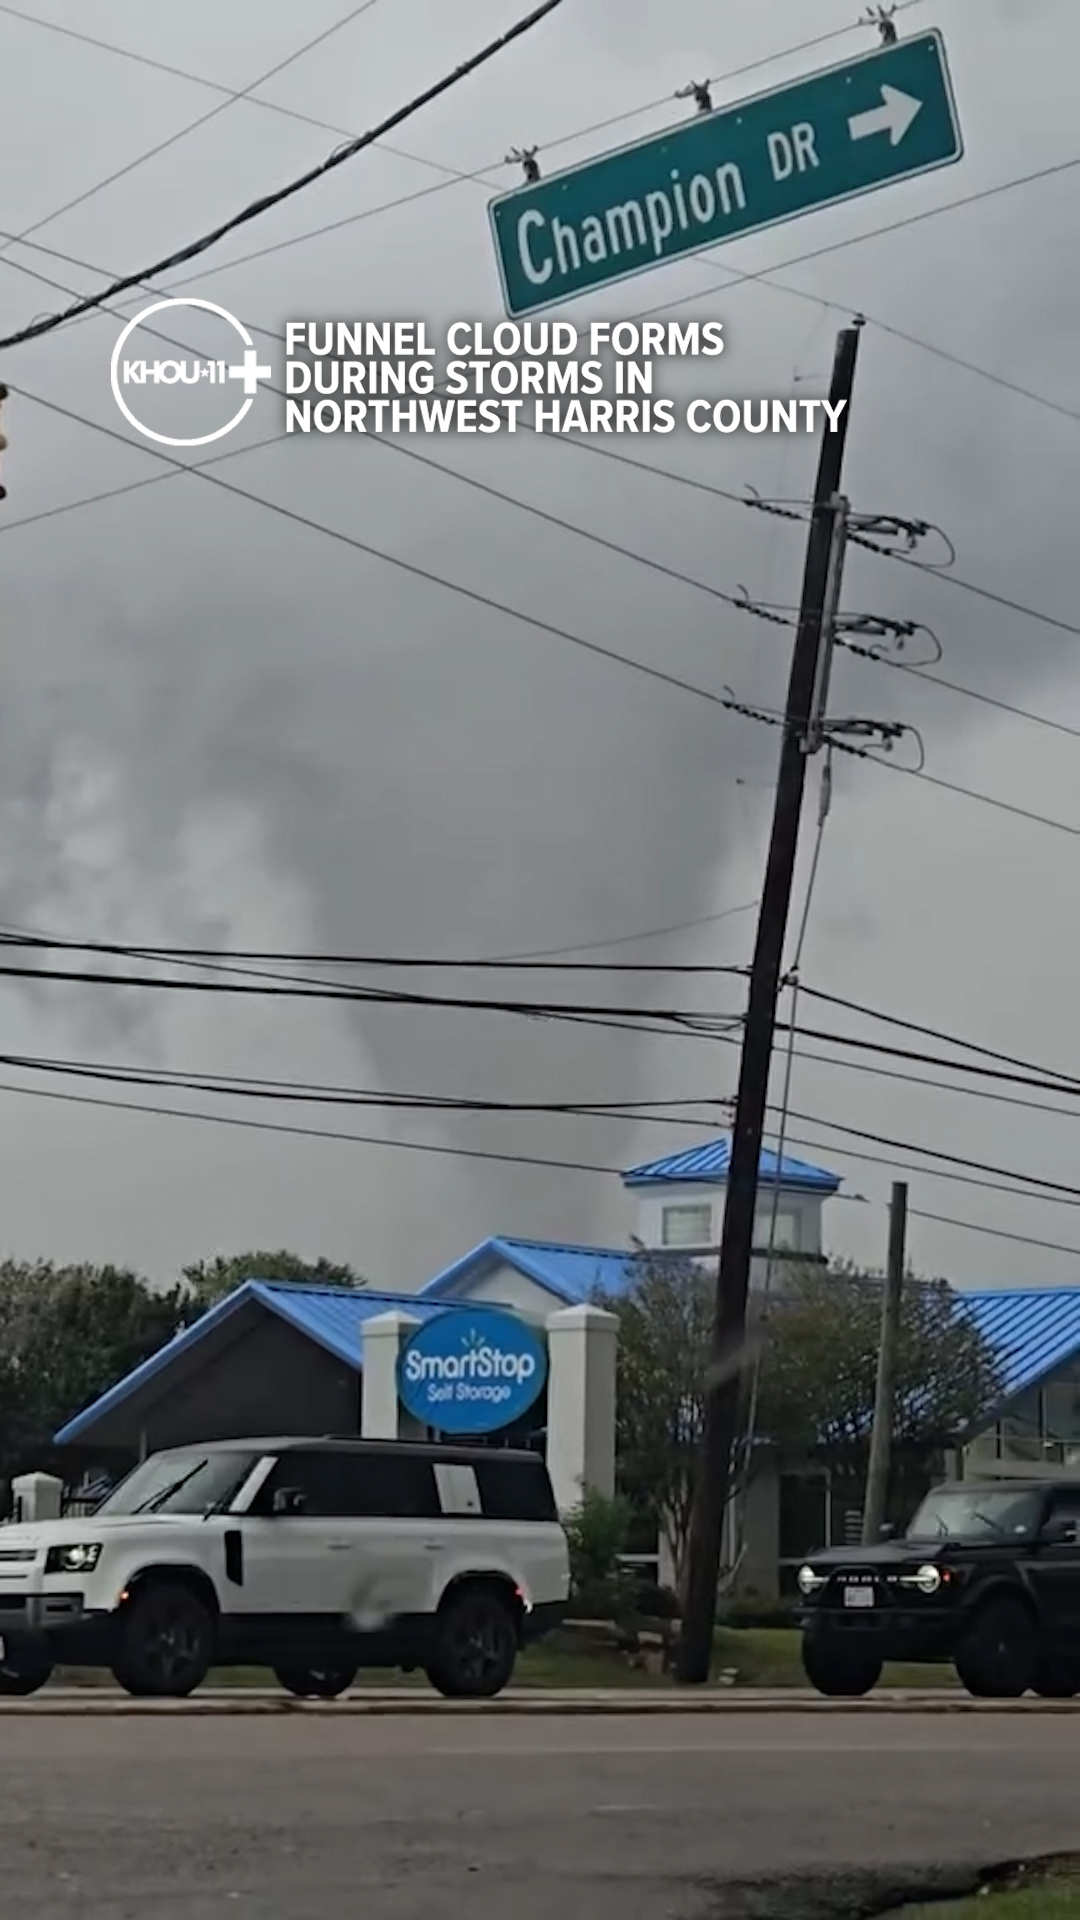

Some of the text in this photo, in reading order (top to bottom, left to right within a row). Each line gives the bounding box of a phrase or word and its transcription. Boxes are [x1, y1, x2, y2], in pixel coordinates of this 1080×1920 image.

[516, 122, 820, 285] Champion DR
[405, 1346, 535, 1385] SmartStop
[427, 1382, 511, 1403] Self Storage
